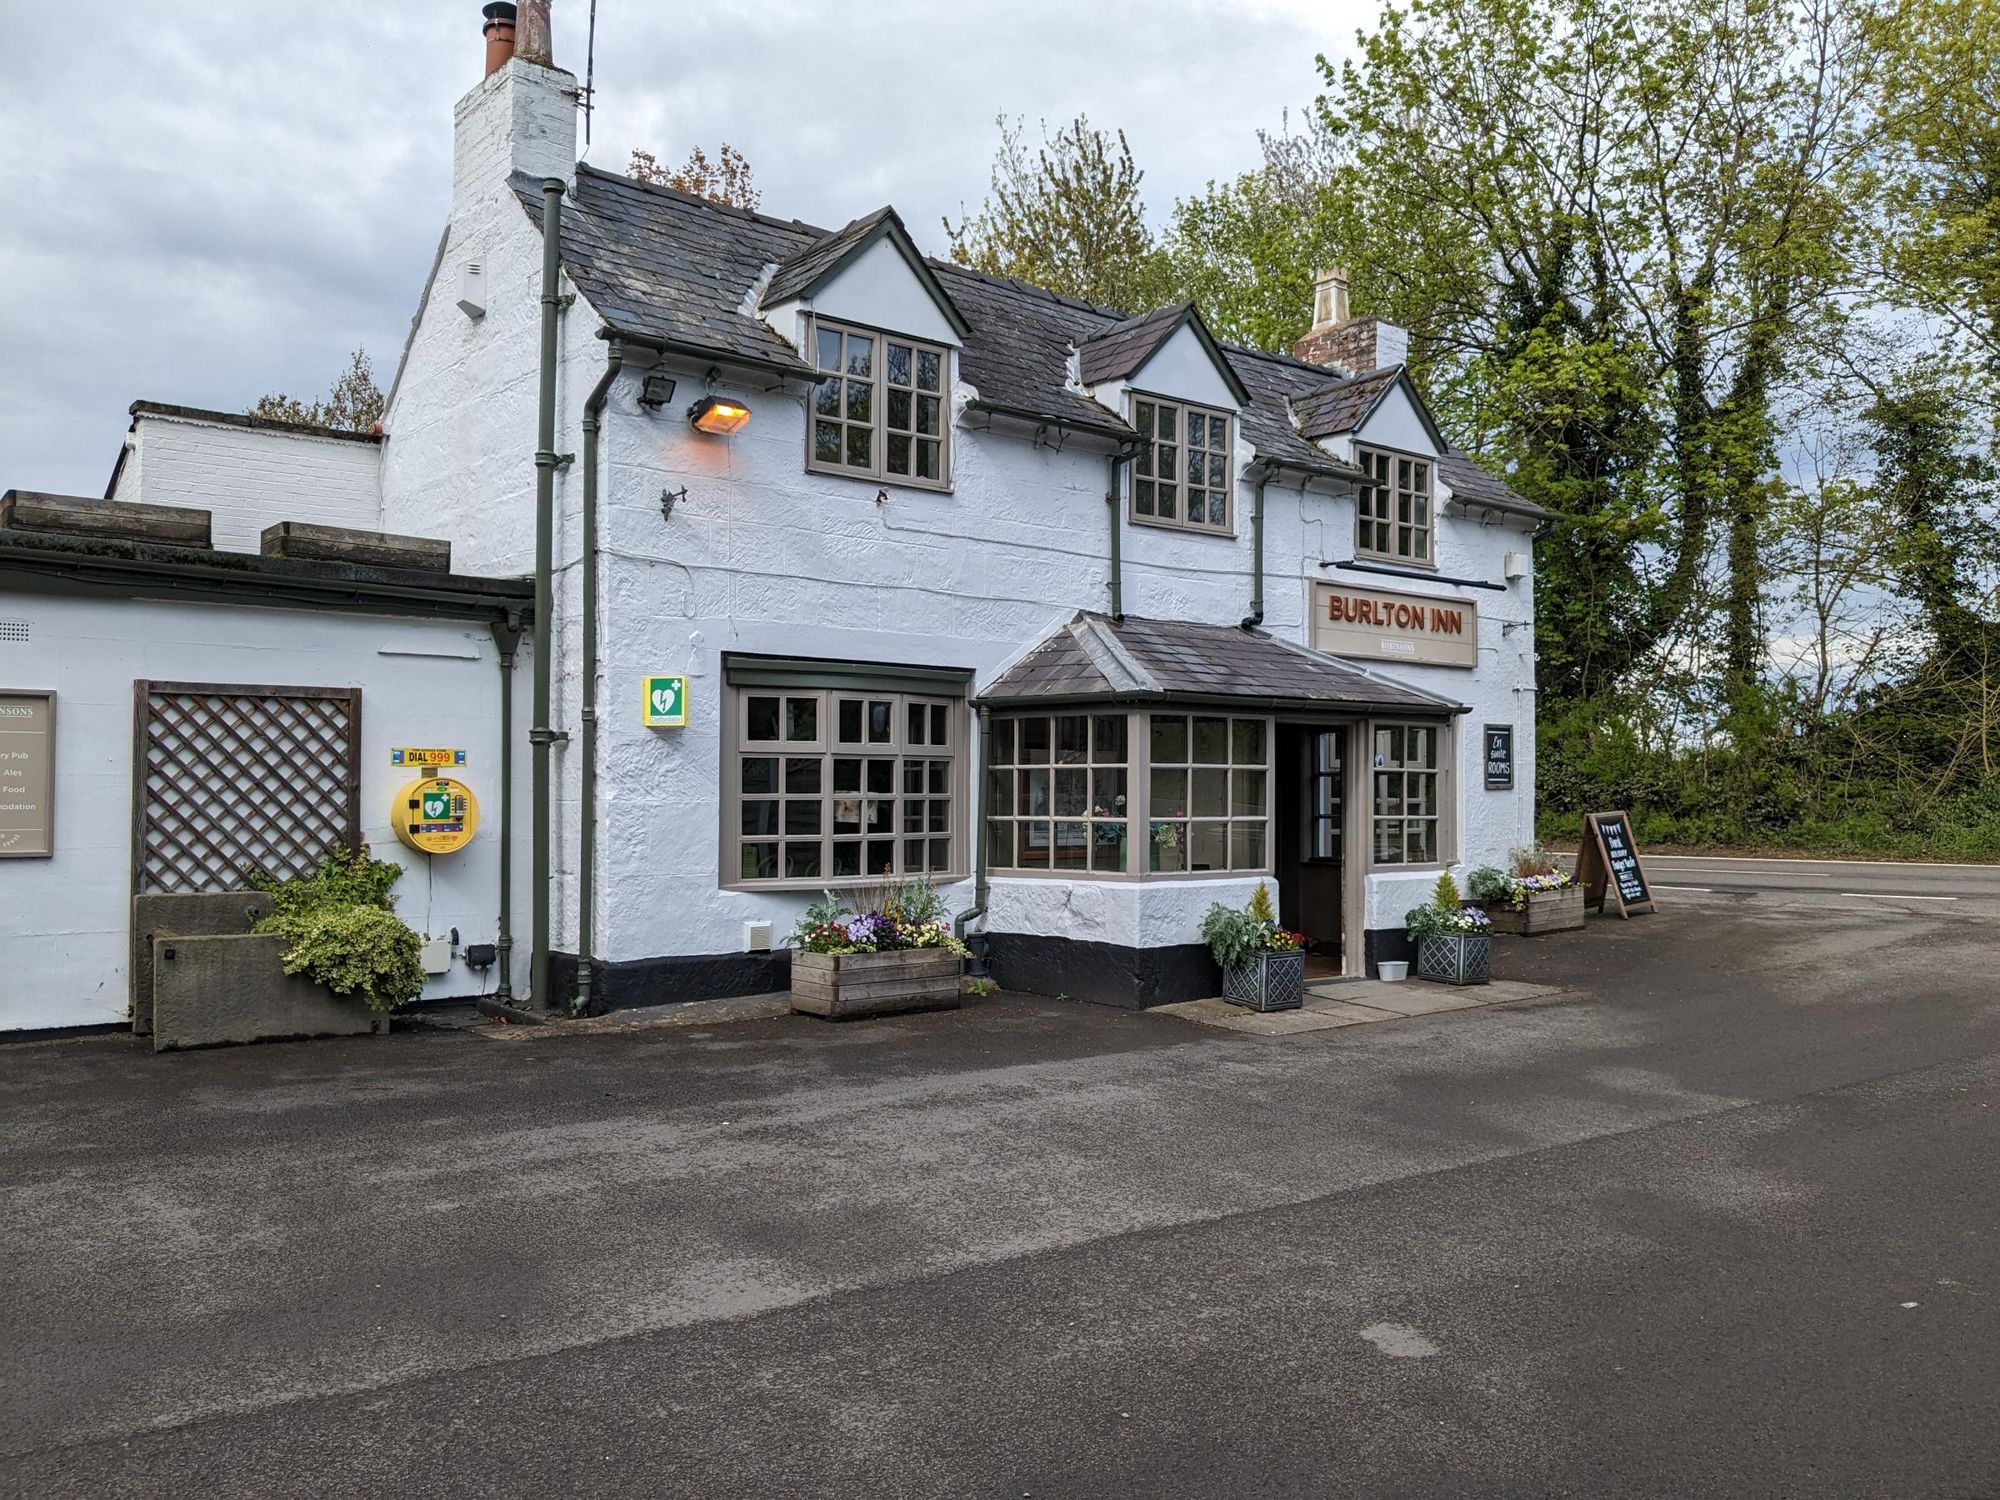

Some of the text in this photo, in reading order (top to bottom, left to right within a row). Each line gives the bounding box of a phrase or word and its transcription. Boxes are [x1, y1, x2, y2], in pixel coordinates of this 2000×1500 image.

[1329, 595, 1462, 634] BURLTON INN
[409, 752, 450, 762] DIAL 999
[1488, 761, 1510, 774] ROOMS
